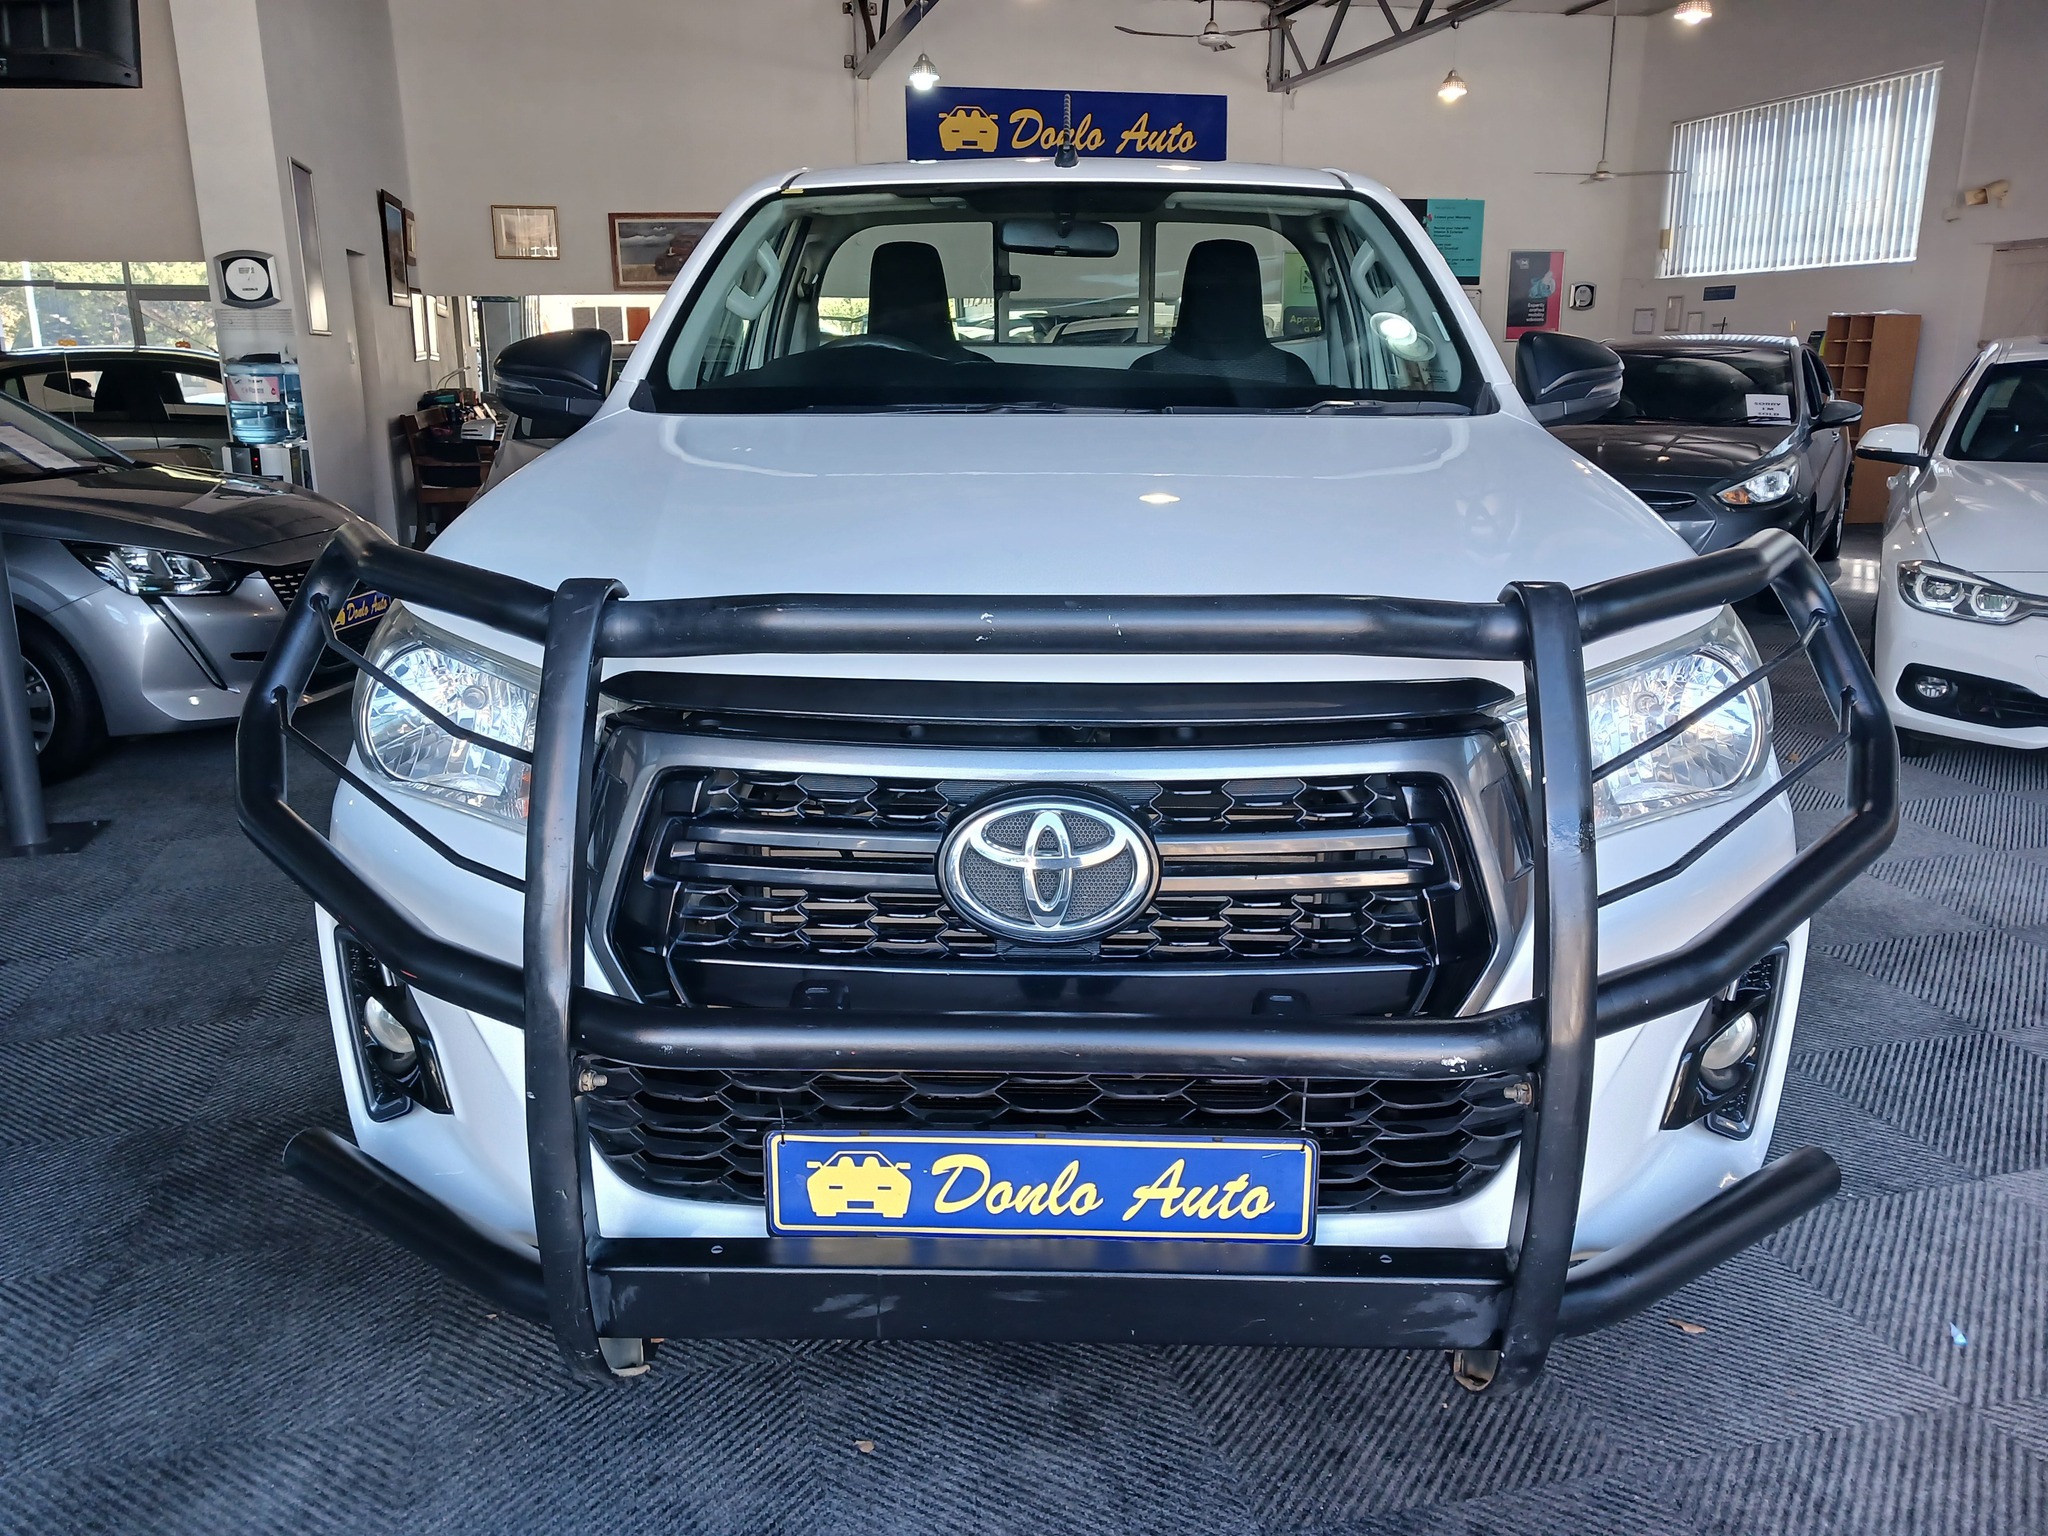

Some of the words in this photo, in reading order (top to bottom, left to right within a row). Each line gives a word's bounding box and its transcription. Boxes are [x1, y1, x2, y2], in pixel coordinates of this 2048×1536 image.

[1115, 112, 1197, 154] Auto
[931, 1153, 1105, 1215] Donlo
[1121, 1158, 1276, 1222] Auto
